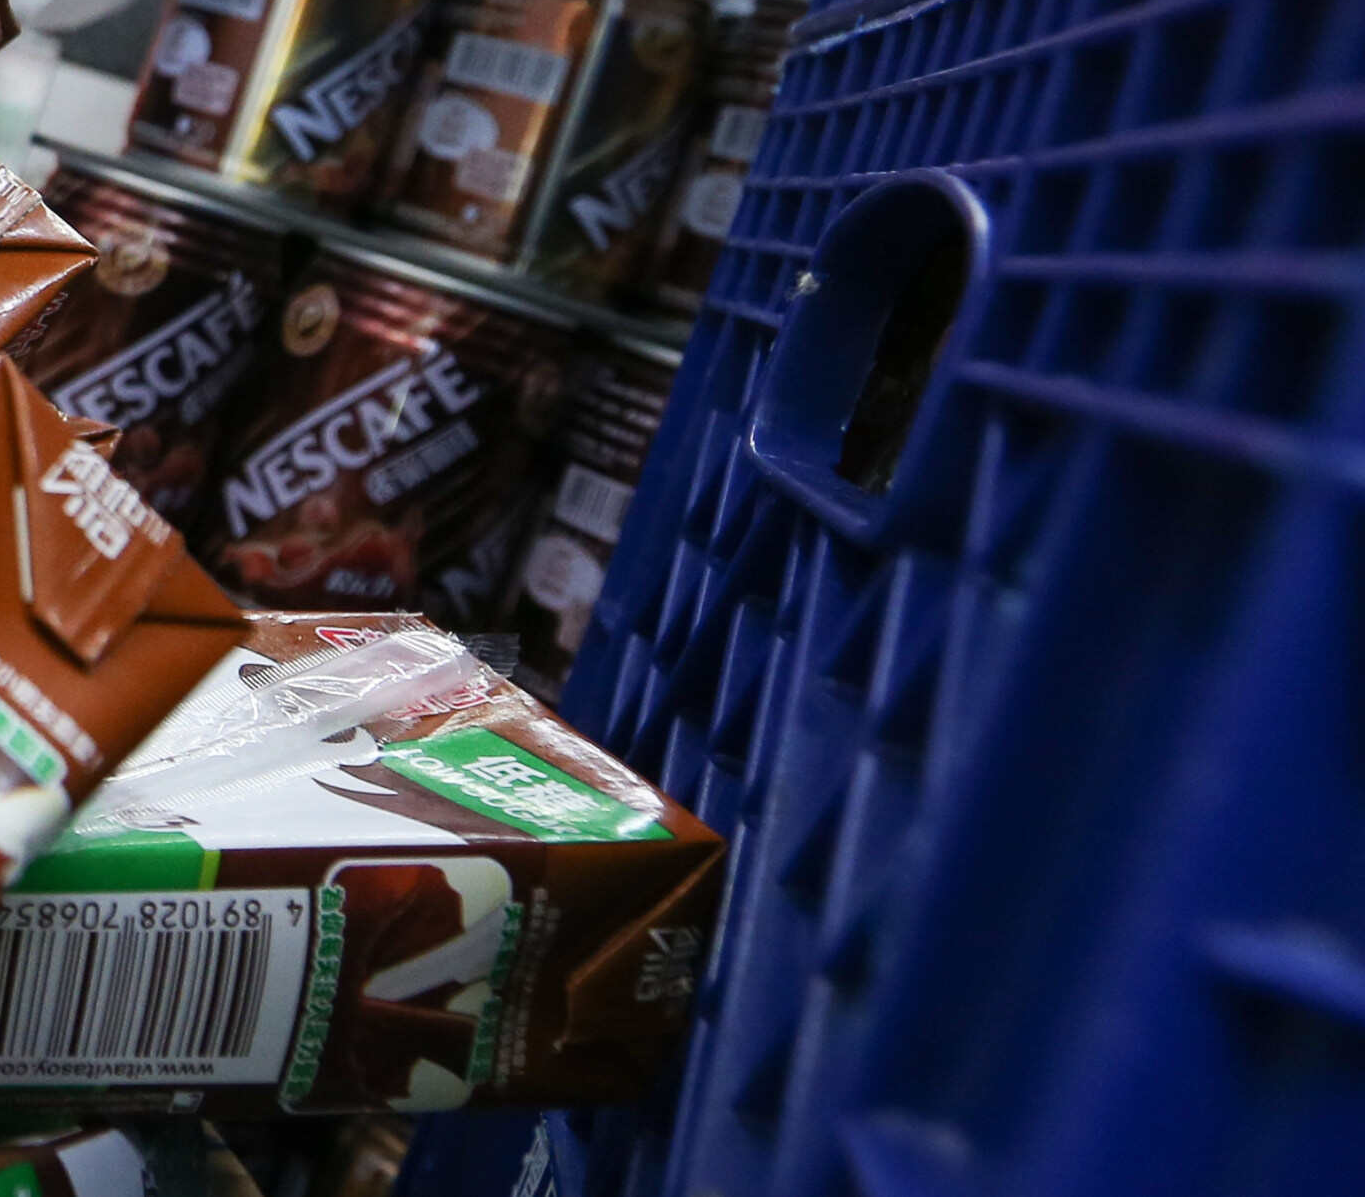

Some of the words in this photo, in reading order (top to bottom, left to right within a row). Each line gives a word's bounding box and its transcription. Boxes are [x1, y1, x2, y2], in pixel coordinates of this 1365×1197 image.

[461, 754, 603, 822] 低糖
[138, 898, 262, 928] 891028
[286, 900, 303, 927] 4
